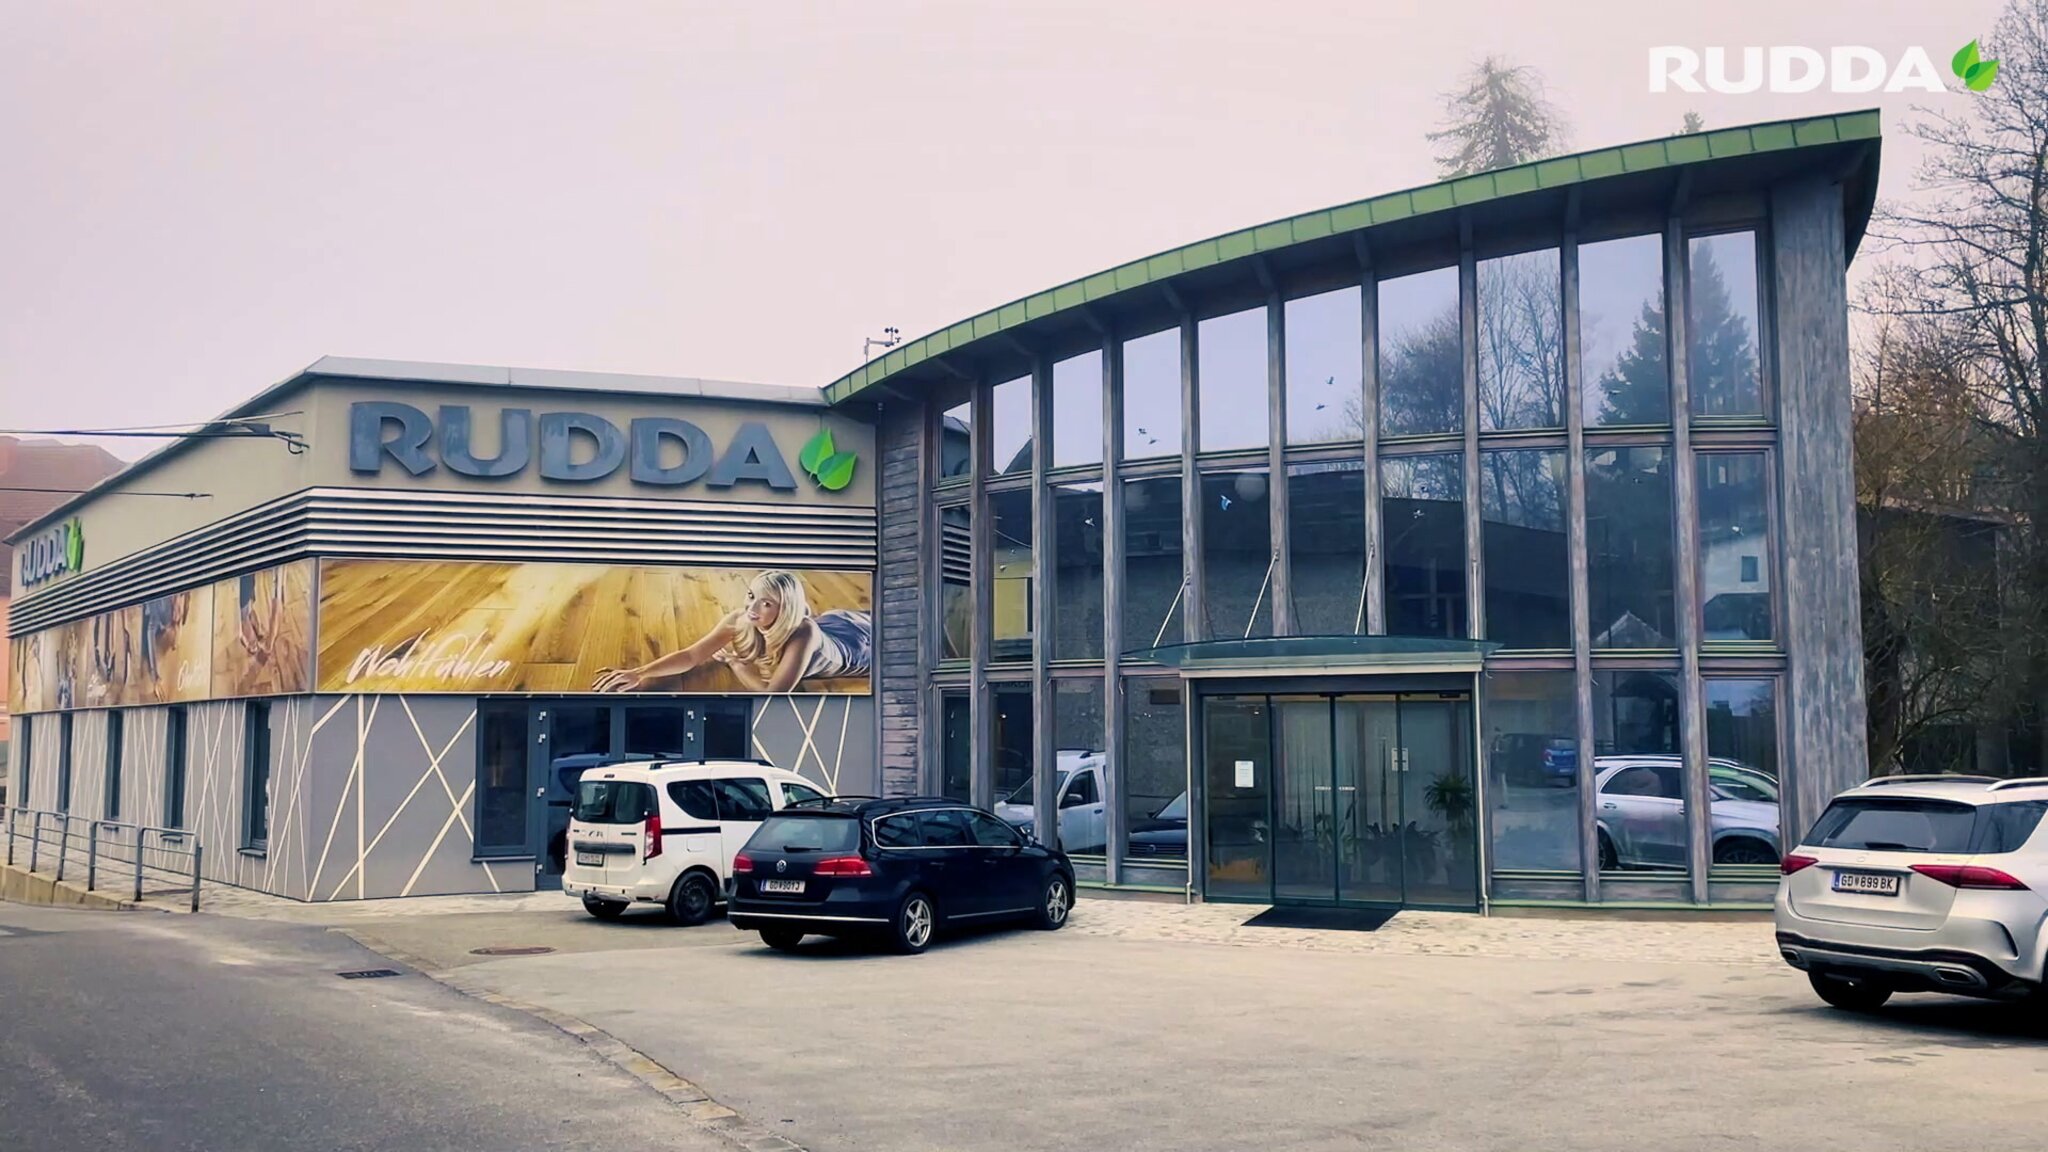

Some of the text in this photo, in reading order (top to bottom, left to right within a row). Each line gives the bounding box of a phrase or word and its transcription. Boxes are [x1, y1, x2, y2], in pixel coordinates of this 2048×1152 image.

[349, 401, 798, 489] RUDDA
[21, 523, 69, 587] RUDDA
[1860, 876, 1879, 889] 899
[1880, 877, 1893, 890] BK
